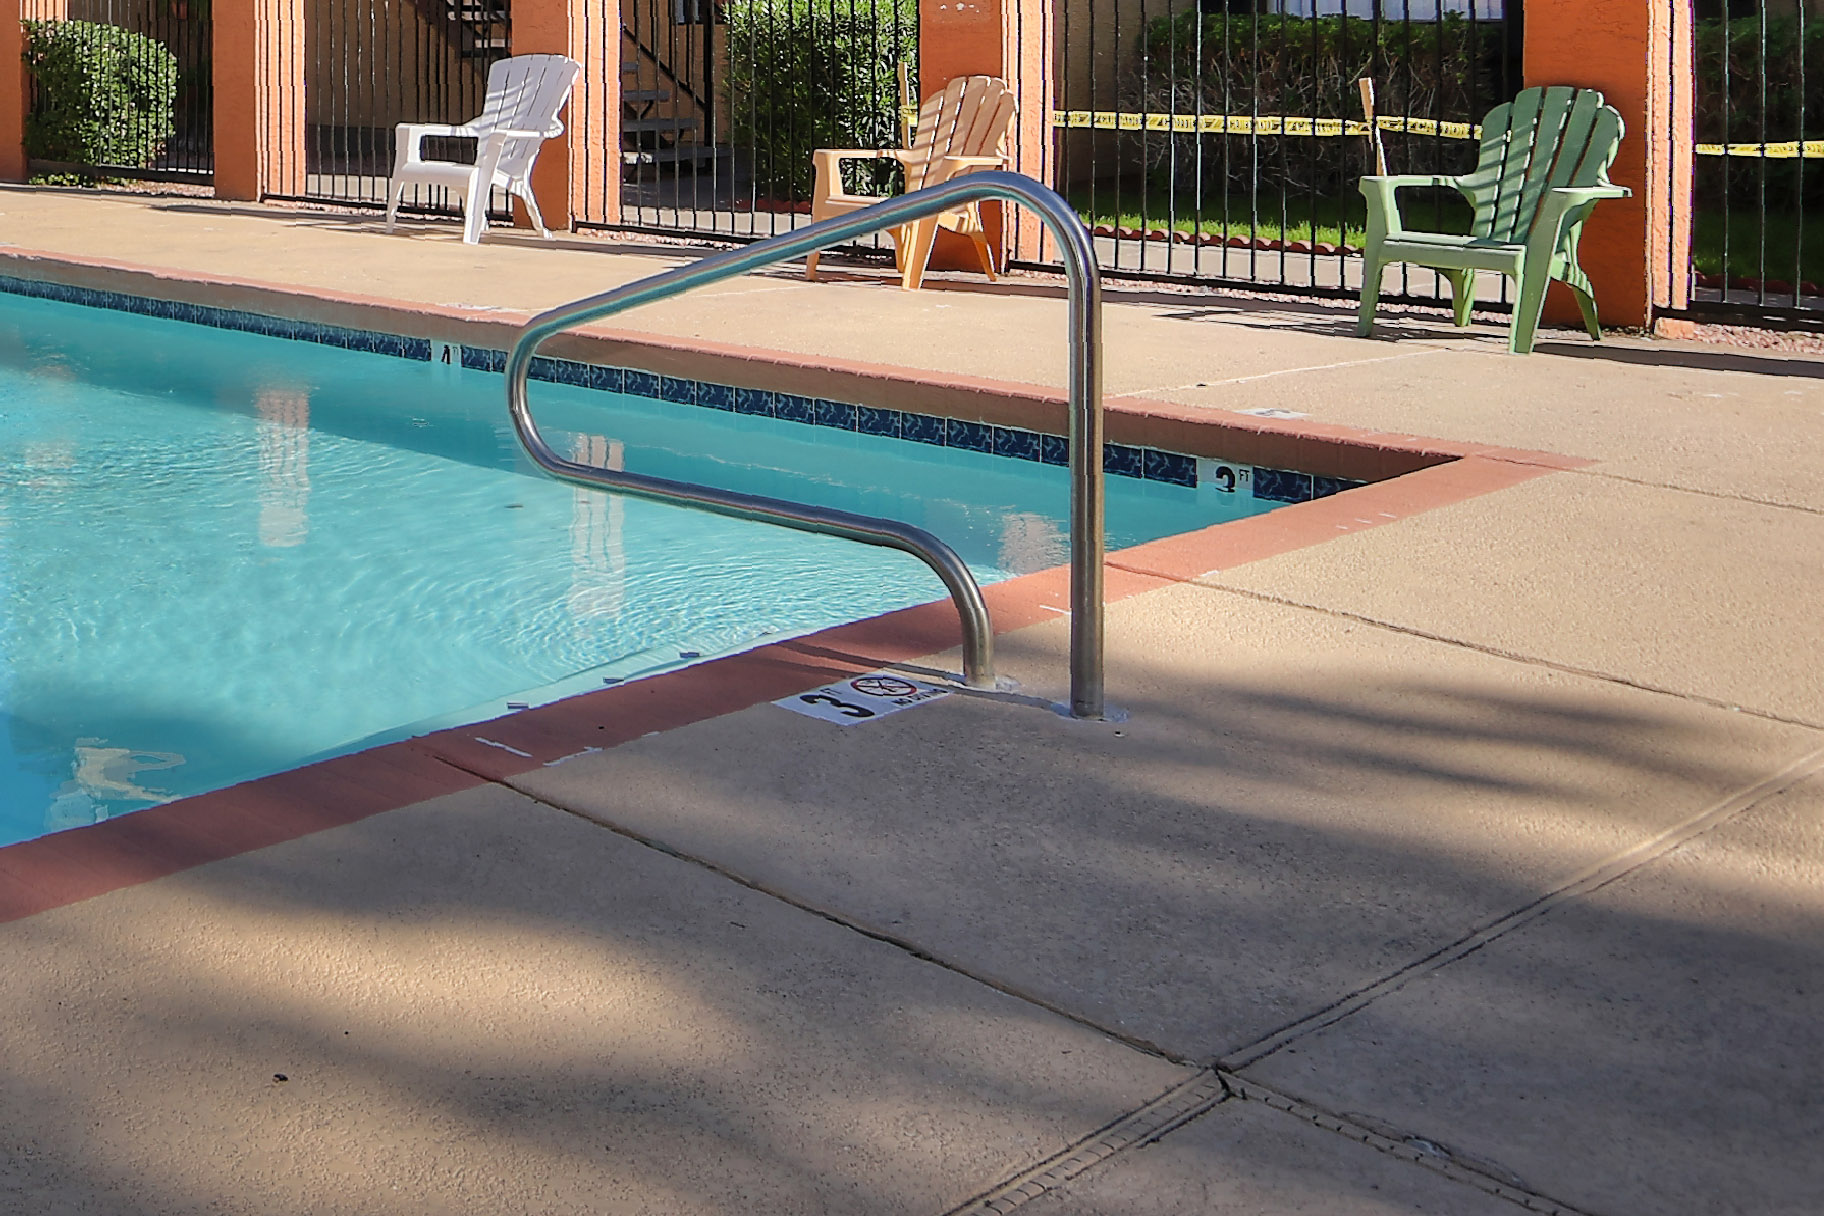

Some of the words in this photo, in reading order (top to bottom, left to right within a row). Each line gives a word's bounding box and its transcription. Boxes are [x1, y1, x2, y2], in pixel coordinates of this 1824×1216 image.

[1238, 469, 1250, 482] FT
[820, 687, 843, 696] FT
[890, 694, 913, 707] NO
[909, 687, 949, 702] DIVING
[799, 694, 876, 718] 3
